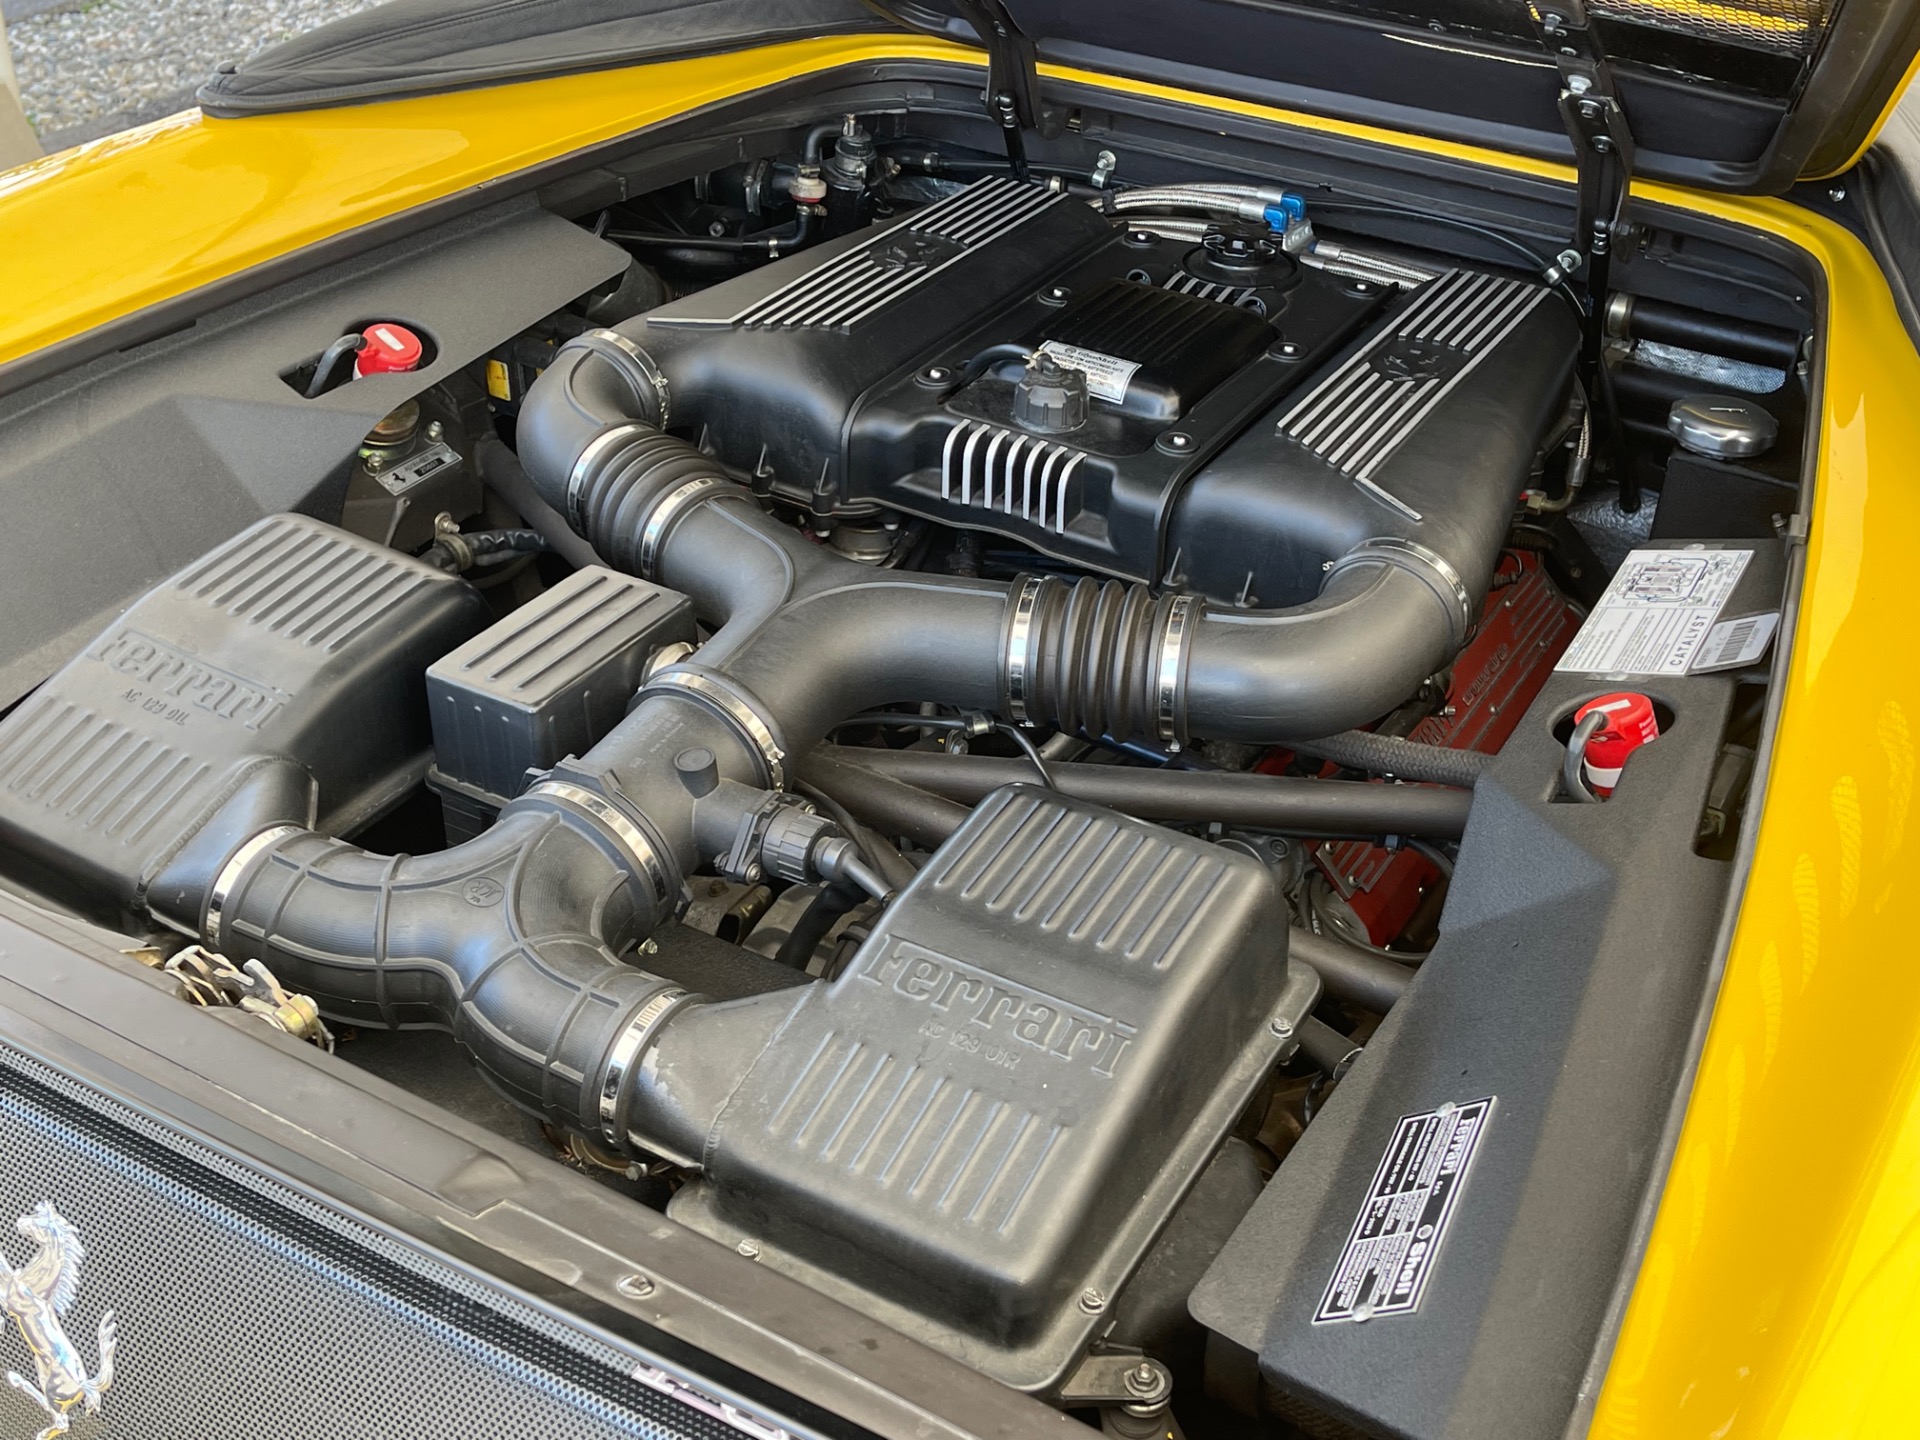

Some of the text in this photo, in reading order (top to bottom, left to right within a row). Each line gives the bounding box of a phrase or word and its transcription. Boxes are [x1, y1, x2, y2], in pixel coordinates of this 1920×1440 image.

[1669, 615, 1708, 667] CATALYST
[86, 629, 293, 731] Ferrari
[120, 688, 143, 703] AC
[142, 697, 168, 714] 129
[857, 933, 1138, 1078] Ferrari
[918, 1018, 944, 1039] AC
[949, 1029, 983, 1054] 129
[1439, 1116, 1477, 1175] Ferrari
[1394, 1240, 1428, 1296] Shell
